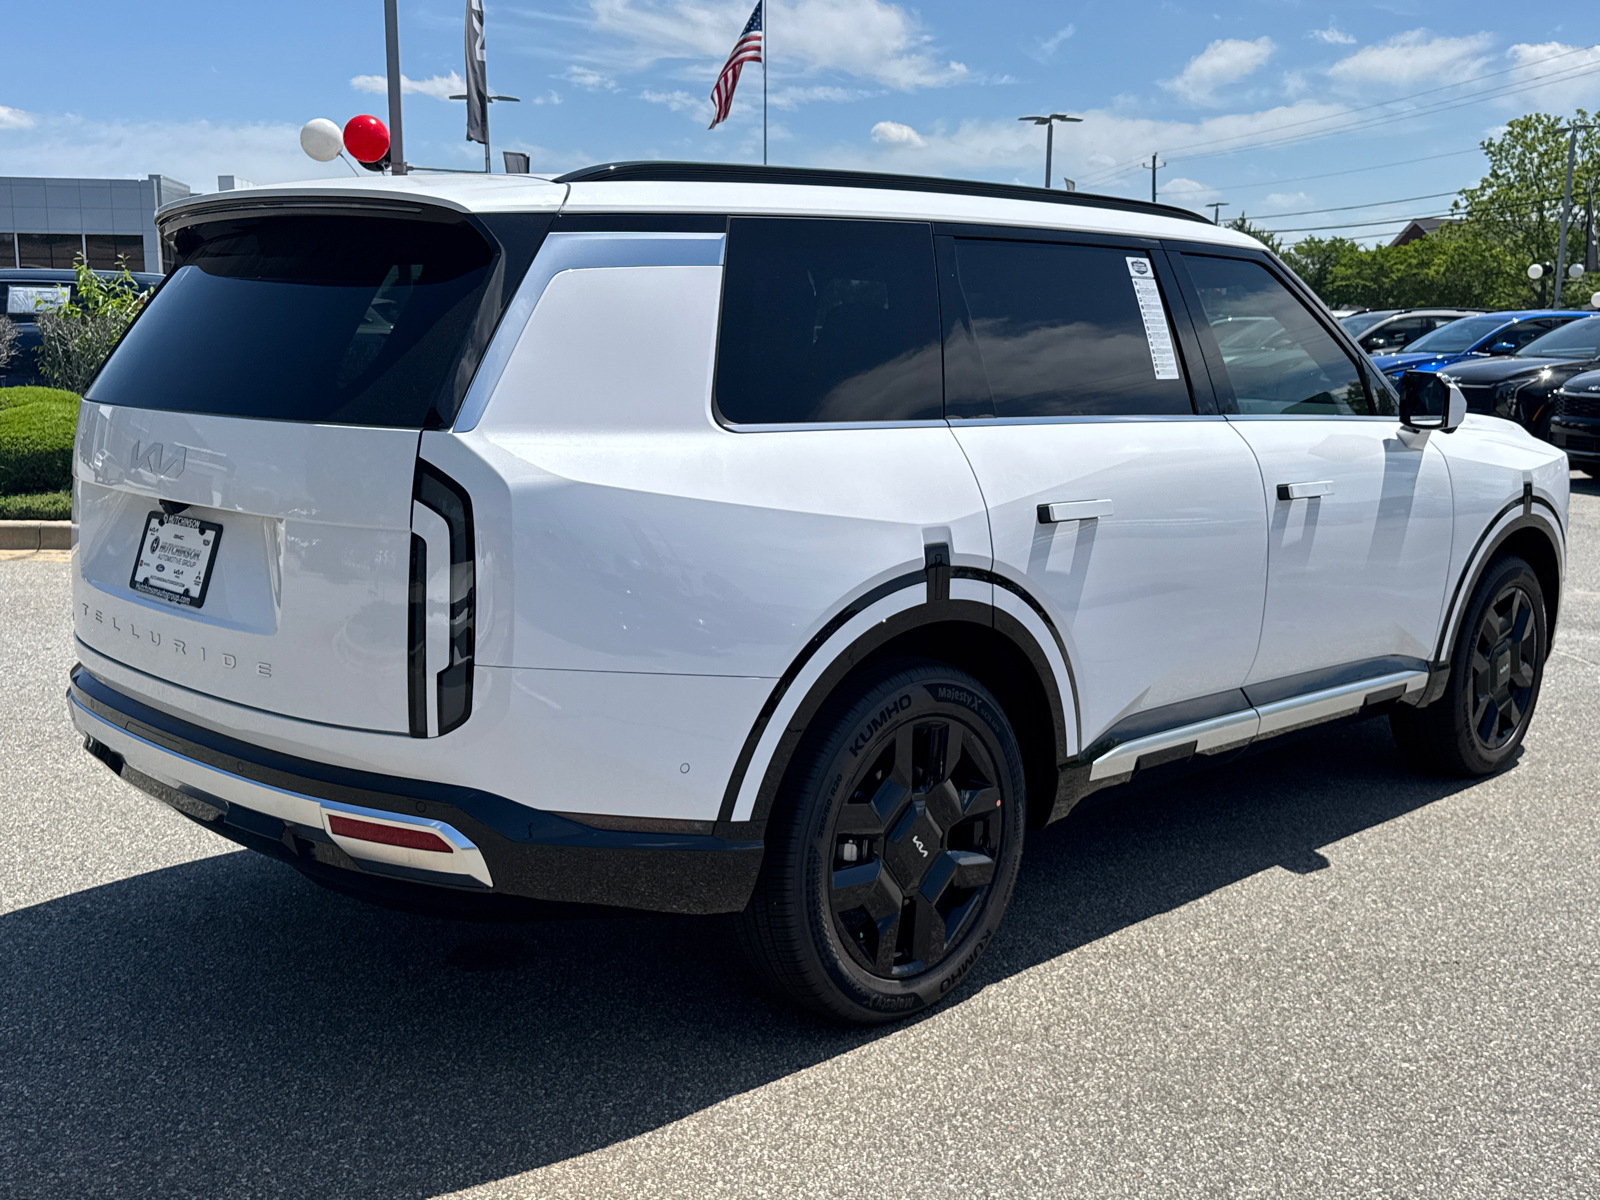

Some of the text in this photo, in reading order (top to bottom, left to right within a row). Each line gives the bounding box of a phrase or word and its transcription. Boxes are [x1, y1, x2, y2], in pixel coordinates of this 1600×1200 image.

[168, 515, 201, 530] HUTCHINSON
[157, 554, 182, 565] AUTOMOTIVE
[181, 557, 197, 568] GROUP
[82, 602, 272, 678] TELLURIDE
[848, 693, 912, 758] KUMHO
[939, 929, 993, 994] KUMHO
